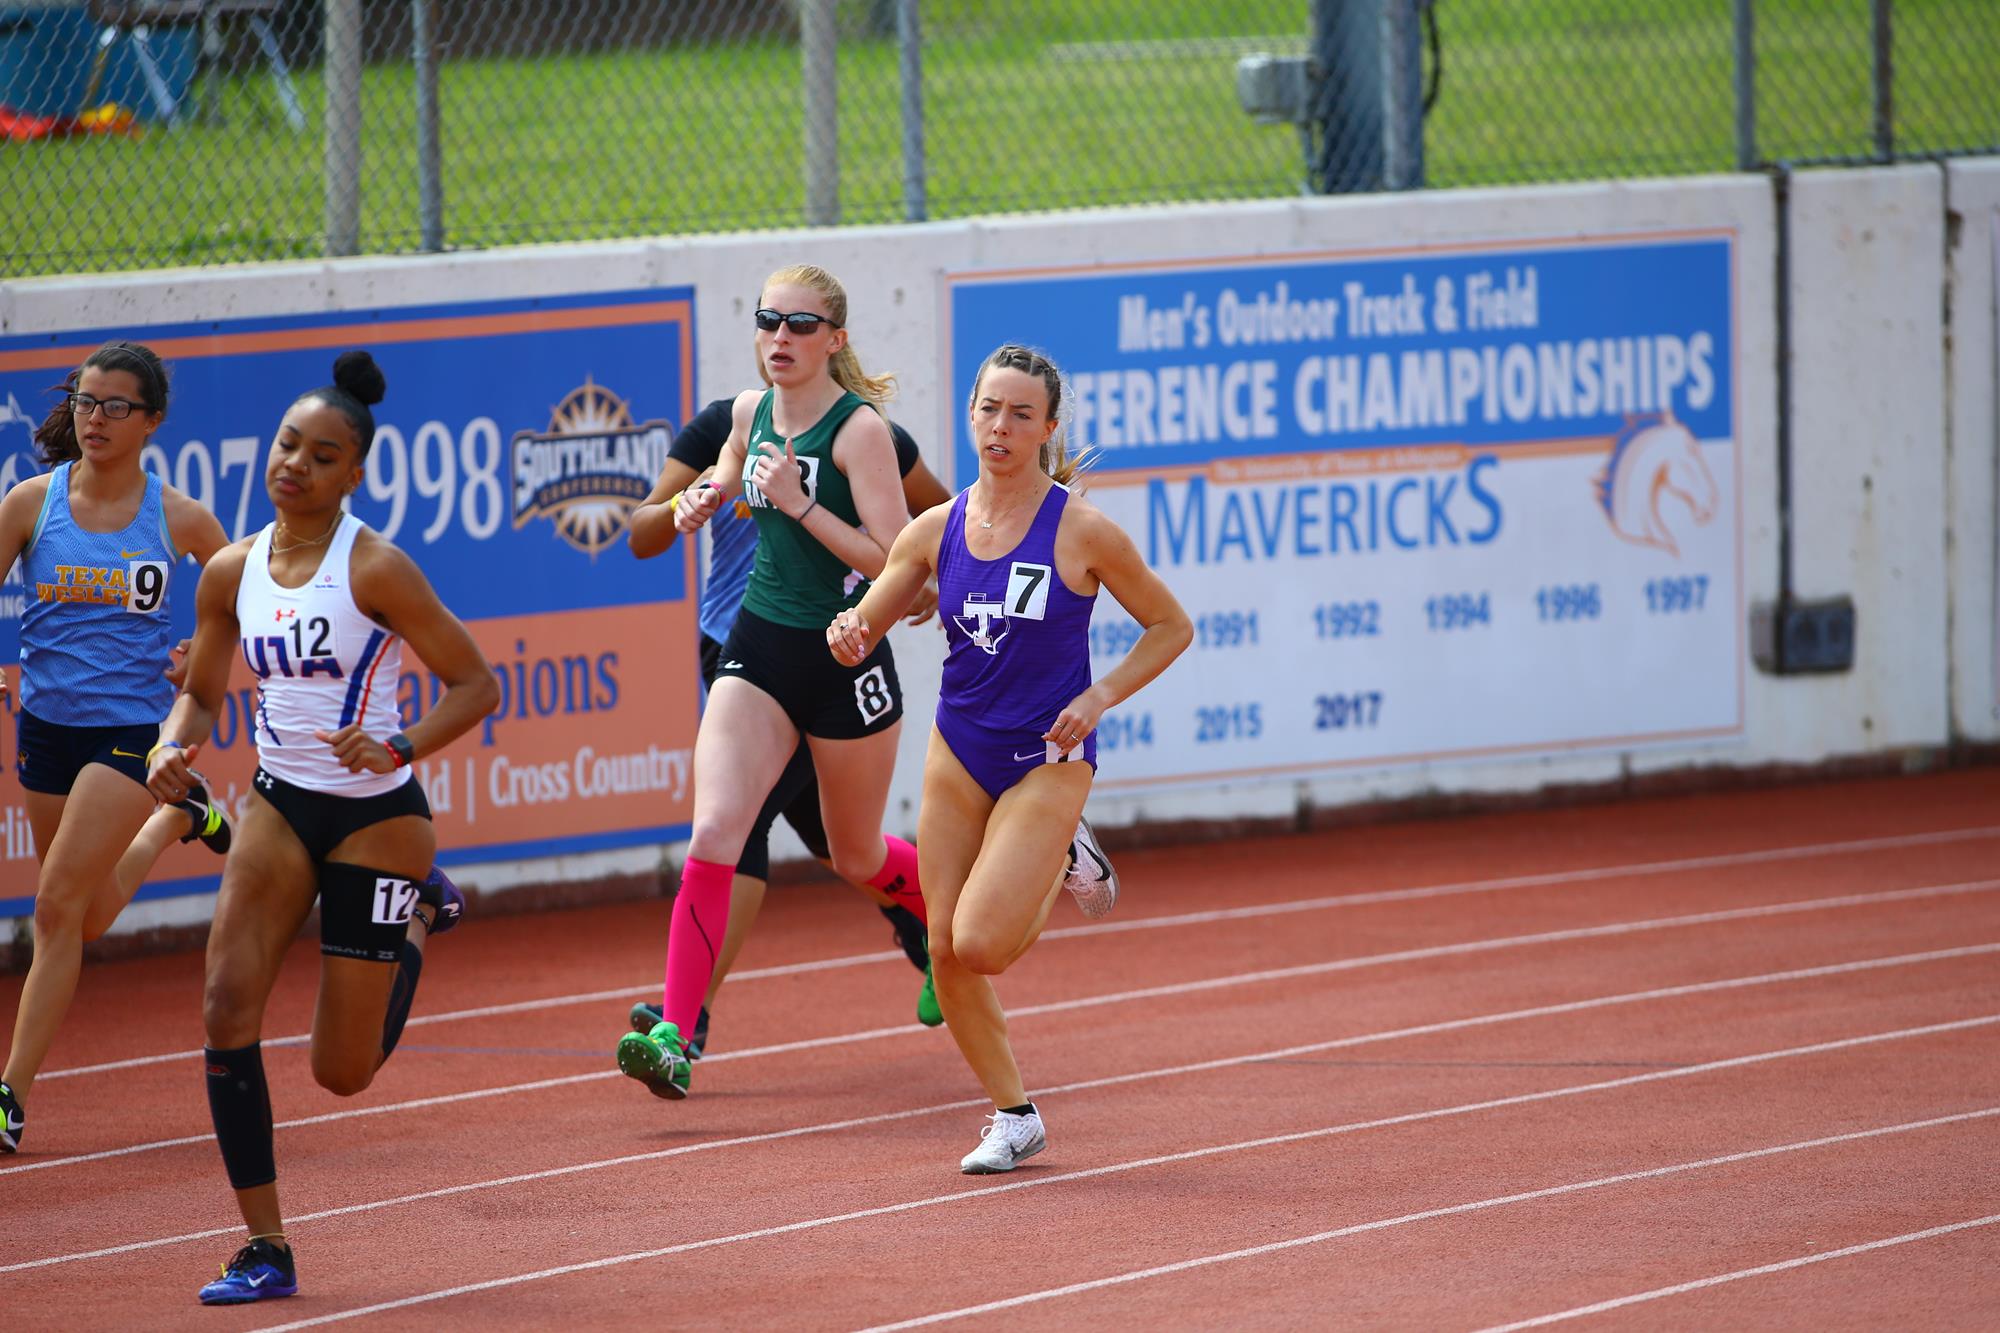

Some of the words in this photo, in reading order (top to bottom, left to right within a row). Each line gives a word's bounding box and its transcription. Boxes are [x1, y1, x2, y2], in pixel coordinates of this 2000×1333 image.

[1118, 291, 1211, 353] Men's
[1217, 281, 1339, 347] Outdoor
[1343, 273, 1427, 338] Track
[1432, 275, 1459, 334] &
[1465, 265, 1539, 332] Field
[1064, 360, 1279, 450] FERENCE
[1292, 330, 1716, 438] CHAMPIONSHIPS
[364, 416, 504, 545] 998
[514, 428, 670, 512] SOUTHLAND
[1146, 454, 1503, 567] MAVERICKS
[36, 582, 132, 608] WESLEY
[55, 565, 134, 588] TEXA
[134, 564, 164, 611] 9
[1013, 566, 1046, 615] 7
[288, 616, 332, 659] 12
[1195, 607, 1259, 648] 1991
[1314, 599, 1382, 641] 1992
[1425, 593, 1492, 633] 1994
[1535, 583, 1601, 623] 1996
[1645, 573, 1710, 614] 1997
[860, 673, 889, 717] 8
[1195, 701, 1262, 745] 2015
[1315, 690, 1383, 731] 2017
[489, 752, 569, 809] Cross
[574, 744, 692, 803] Country
[379, 881, 417, 921] 12
